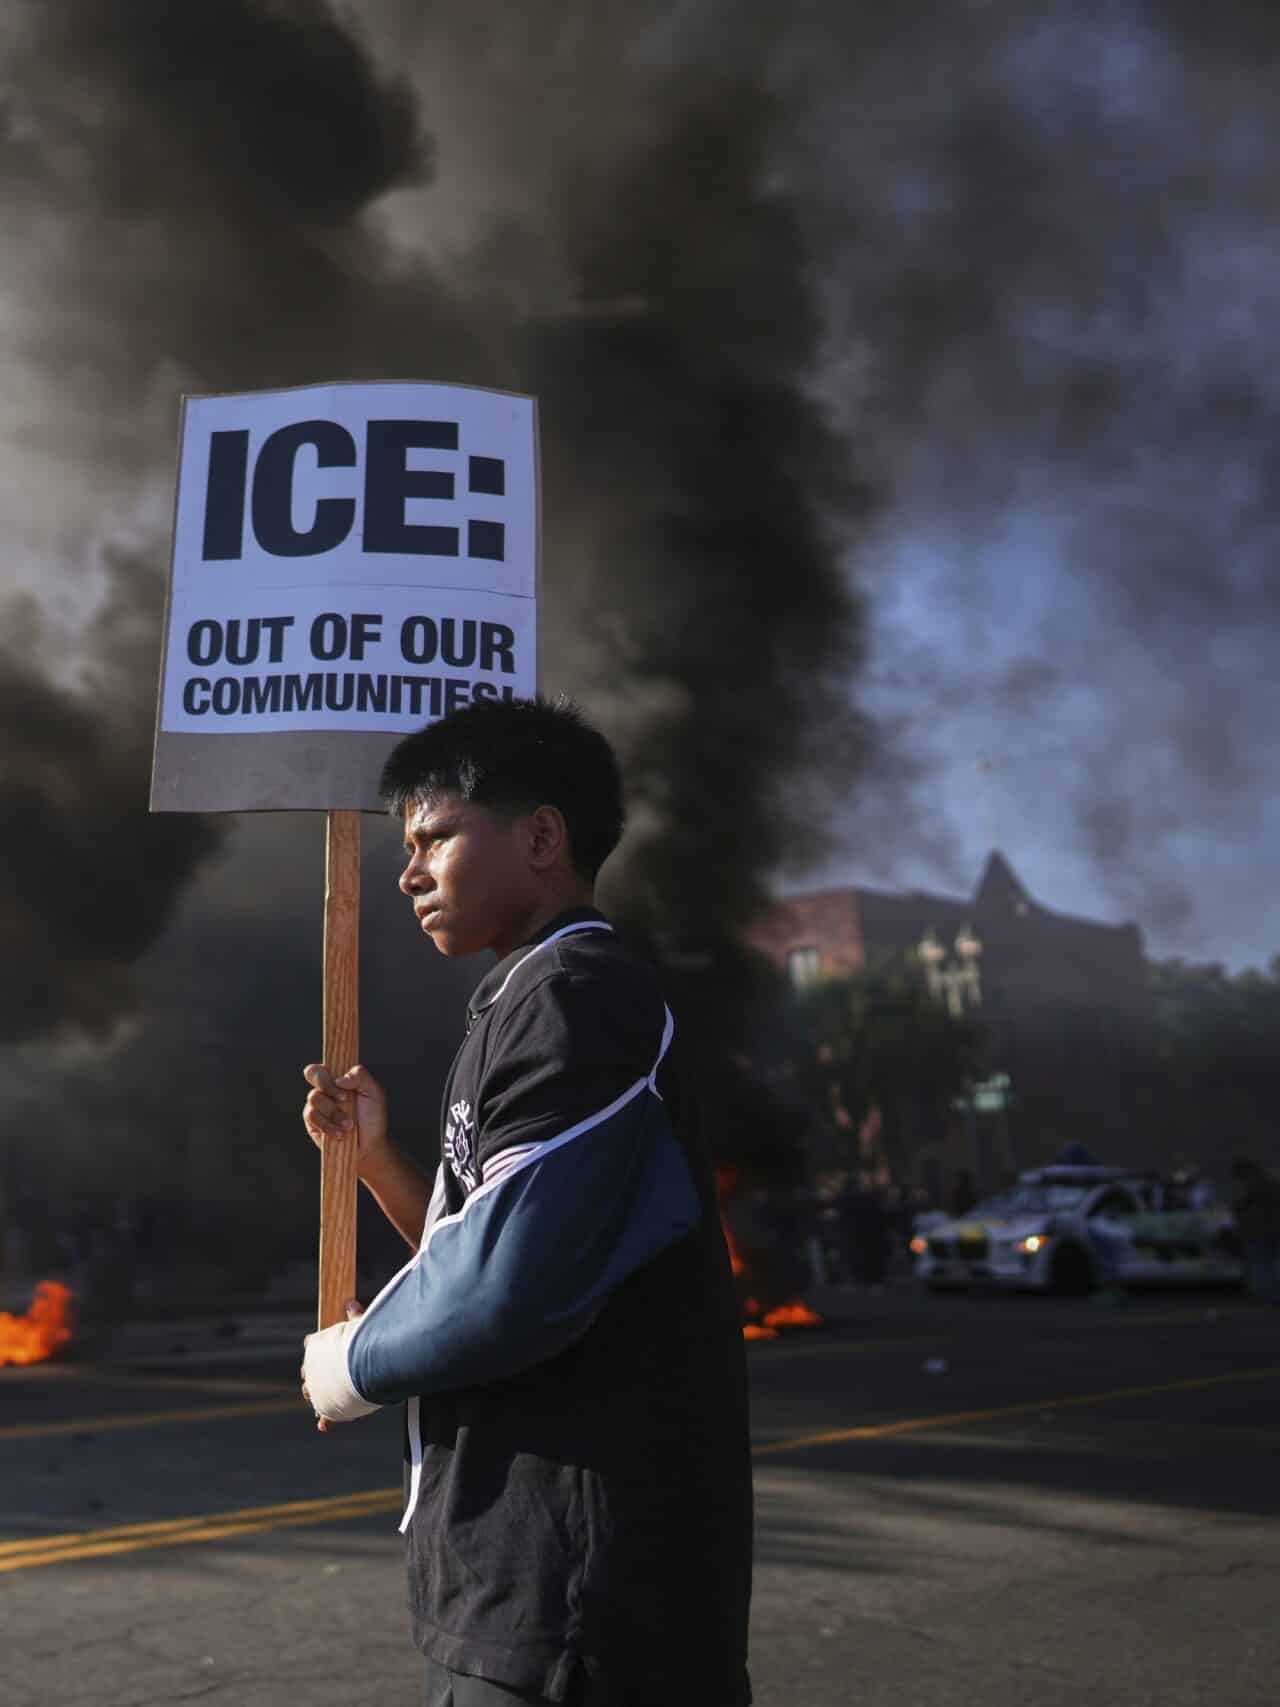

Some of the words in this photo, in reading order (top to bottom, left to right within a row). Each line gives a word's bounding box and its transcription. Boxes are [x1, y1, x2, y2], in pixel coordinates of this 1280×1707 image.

[201, 419, 506, 562] ICE:
[186, 615, 295, 666] OUT
[309, 612, 383, 661] OF
[400, 615, 517, 673] OUR
